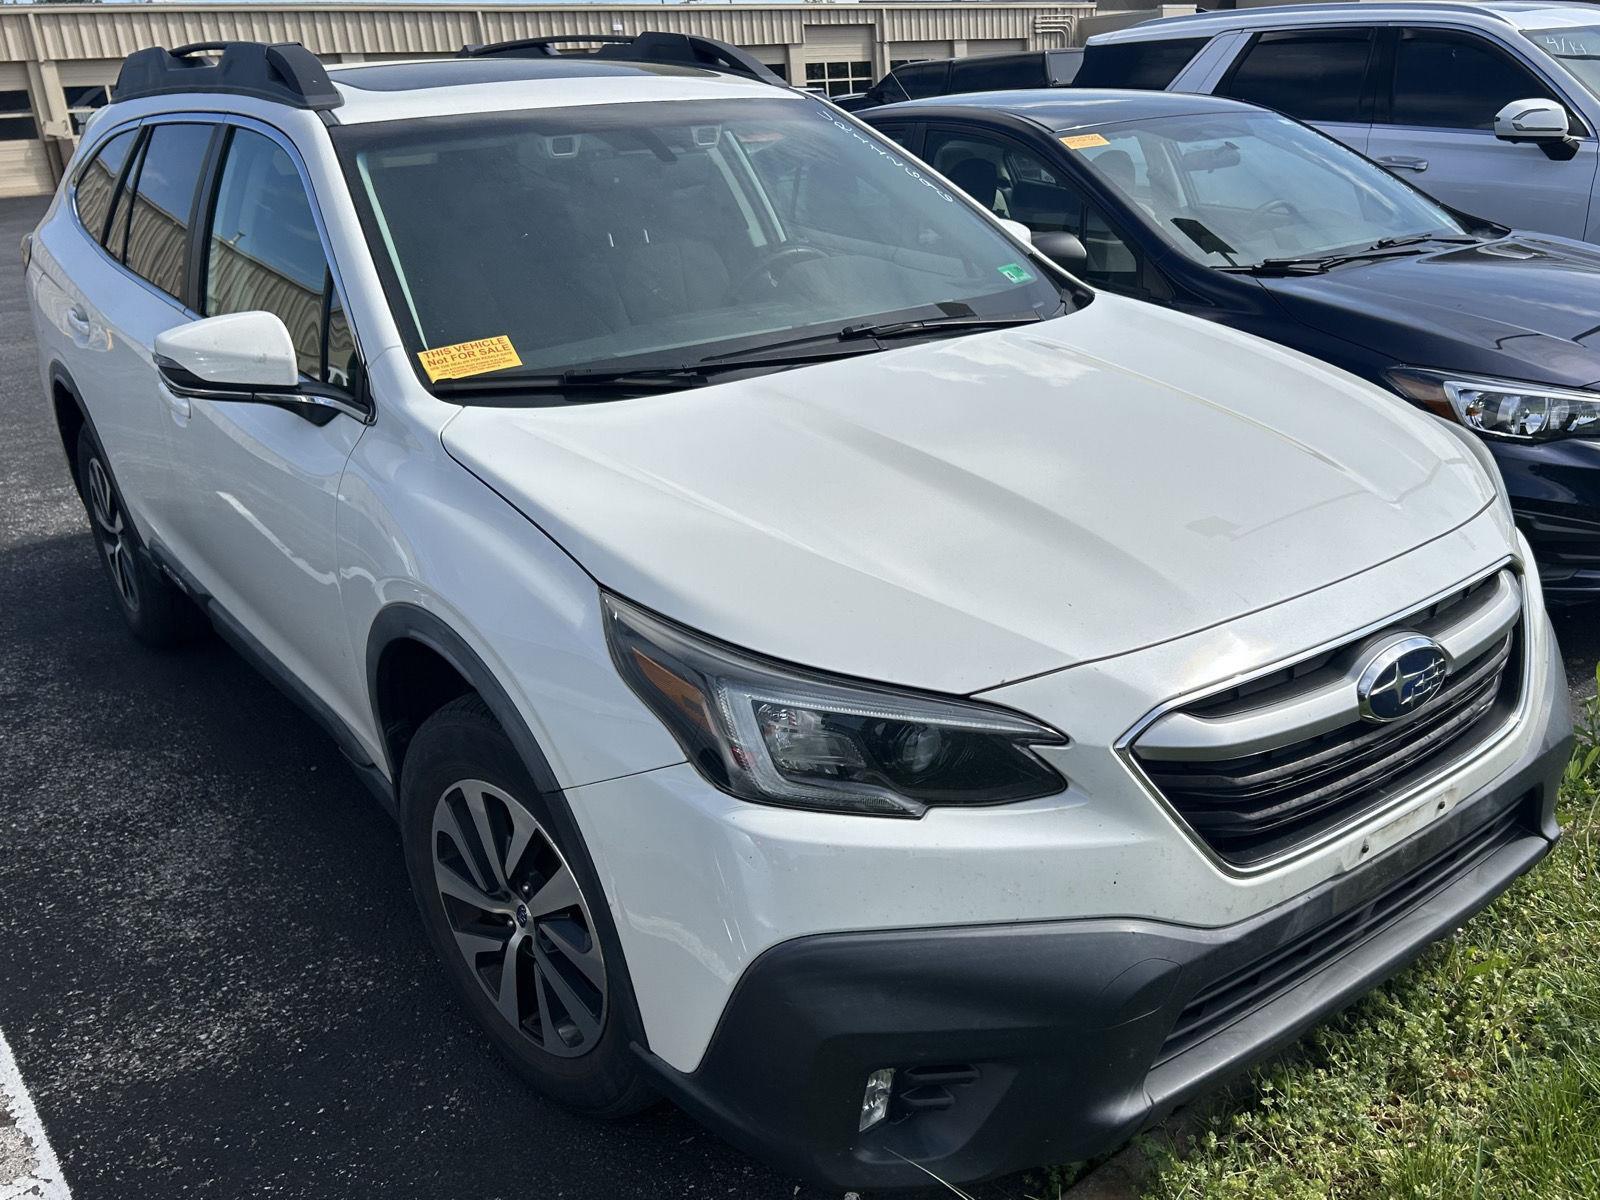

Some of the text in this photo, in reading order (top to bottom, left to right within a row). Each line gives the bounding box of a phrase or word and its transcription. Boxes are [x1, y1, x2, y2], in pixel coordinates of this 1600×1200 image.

[424, 337, 505, 360] THIS VEHICLE
[427, 356, 449, 367] Not
[451, 350, 477, 362] FOR
[479, 343, 511, 356] SALE
